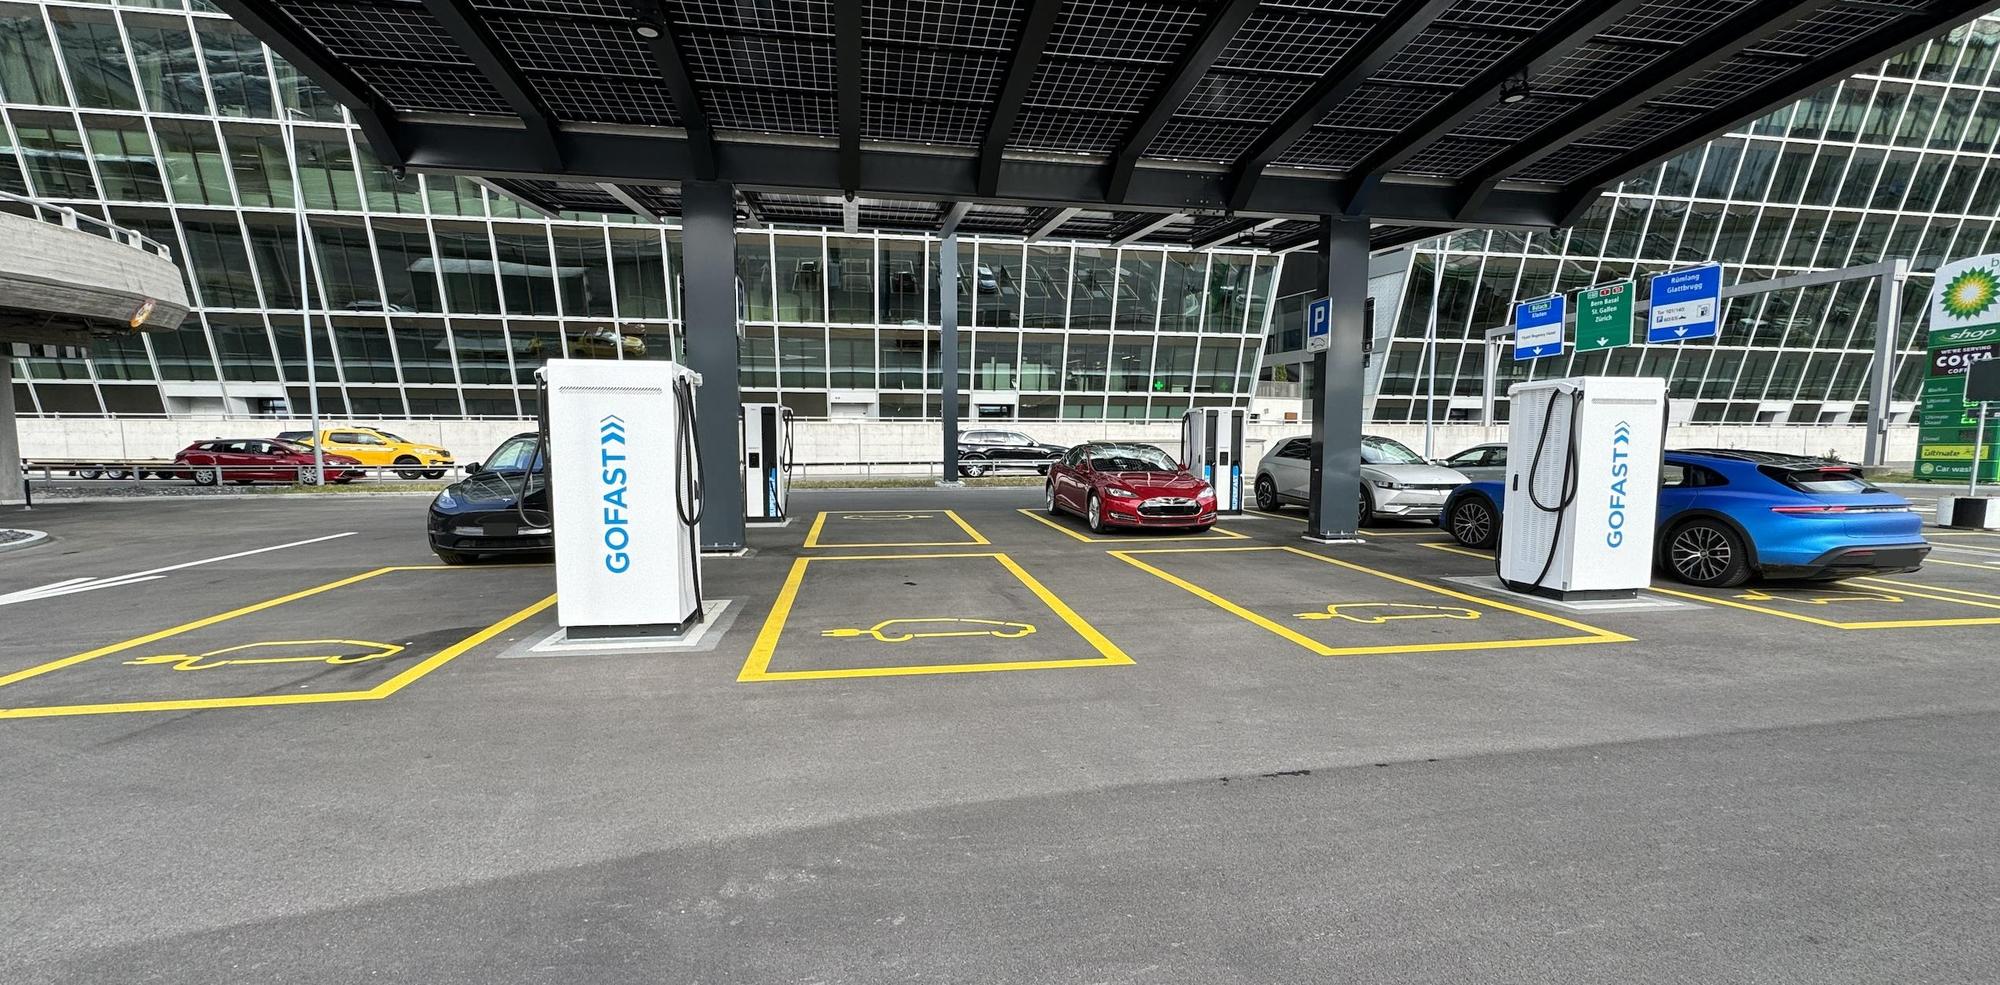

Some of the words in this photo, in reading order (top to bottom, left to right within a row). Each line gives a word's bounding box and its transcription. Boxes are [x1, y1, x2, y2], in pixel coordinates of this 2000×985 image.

[1671, 274, 1700, 283] Rümlang
[1667, 283, 1702, 293] Glattbrugg
[1314, 306, 1325, 332] P
[1950, 328, 1997, 341] shop
[1963, 345, 1992, 353] SERVING
[1924, 449, 1960, 457] ultimate
[1607, 448, 1628, 548] GOFAST
[602, 449, 630, 573] GOFAST
